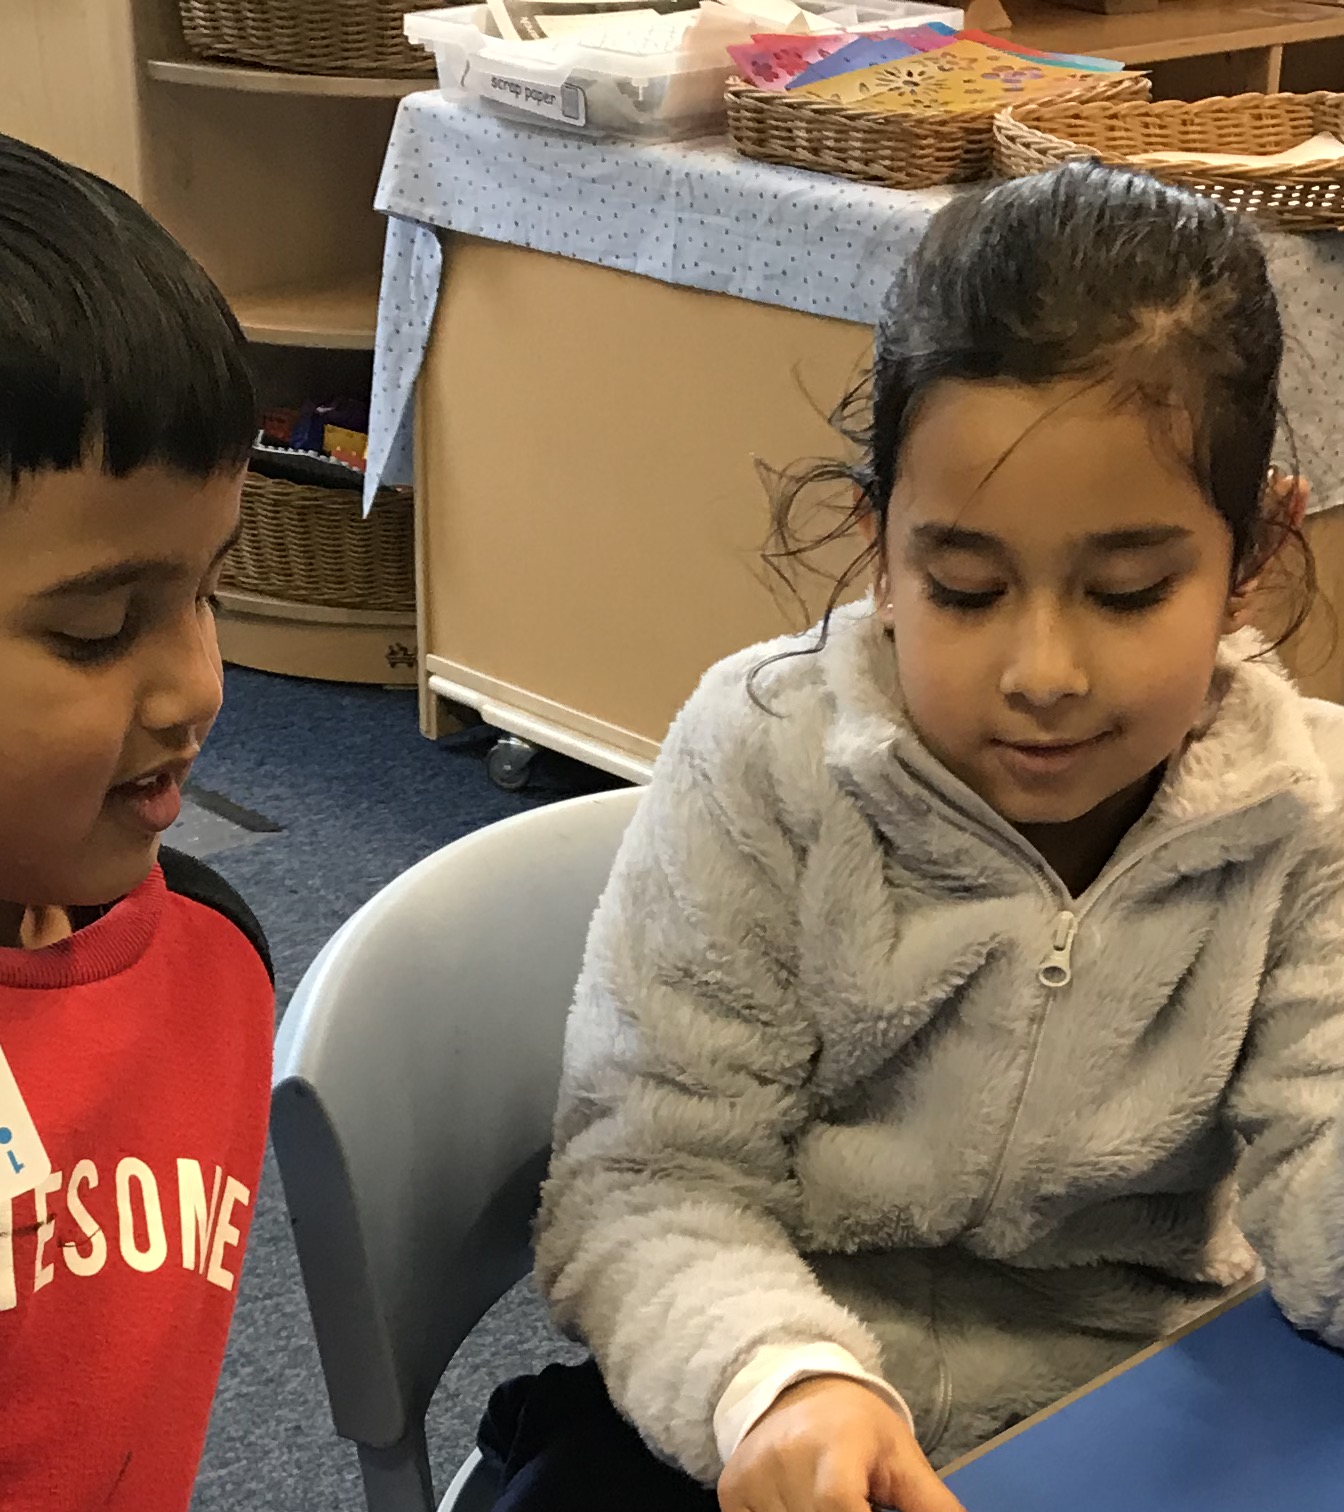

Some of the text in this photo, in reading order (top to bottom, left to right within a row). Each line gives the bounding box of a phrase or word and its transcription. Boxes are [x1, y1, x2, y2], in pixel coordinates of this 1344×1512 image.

[491, 77, 556, 105] scrap paper
[6, 1149, 26, 1175] 1
